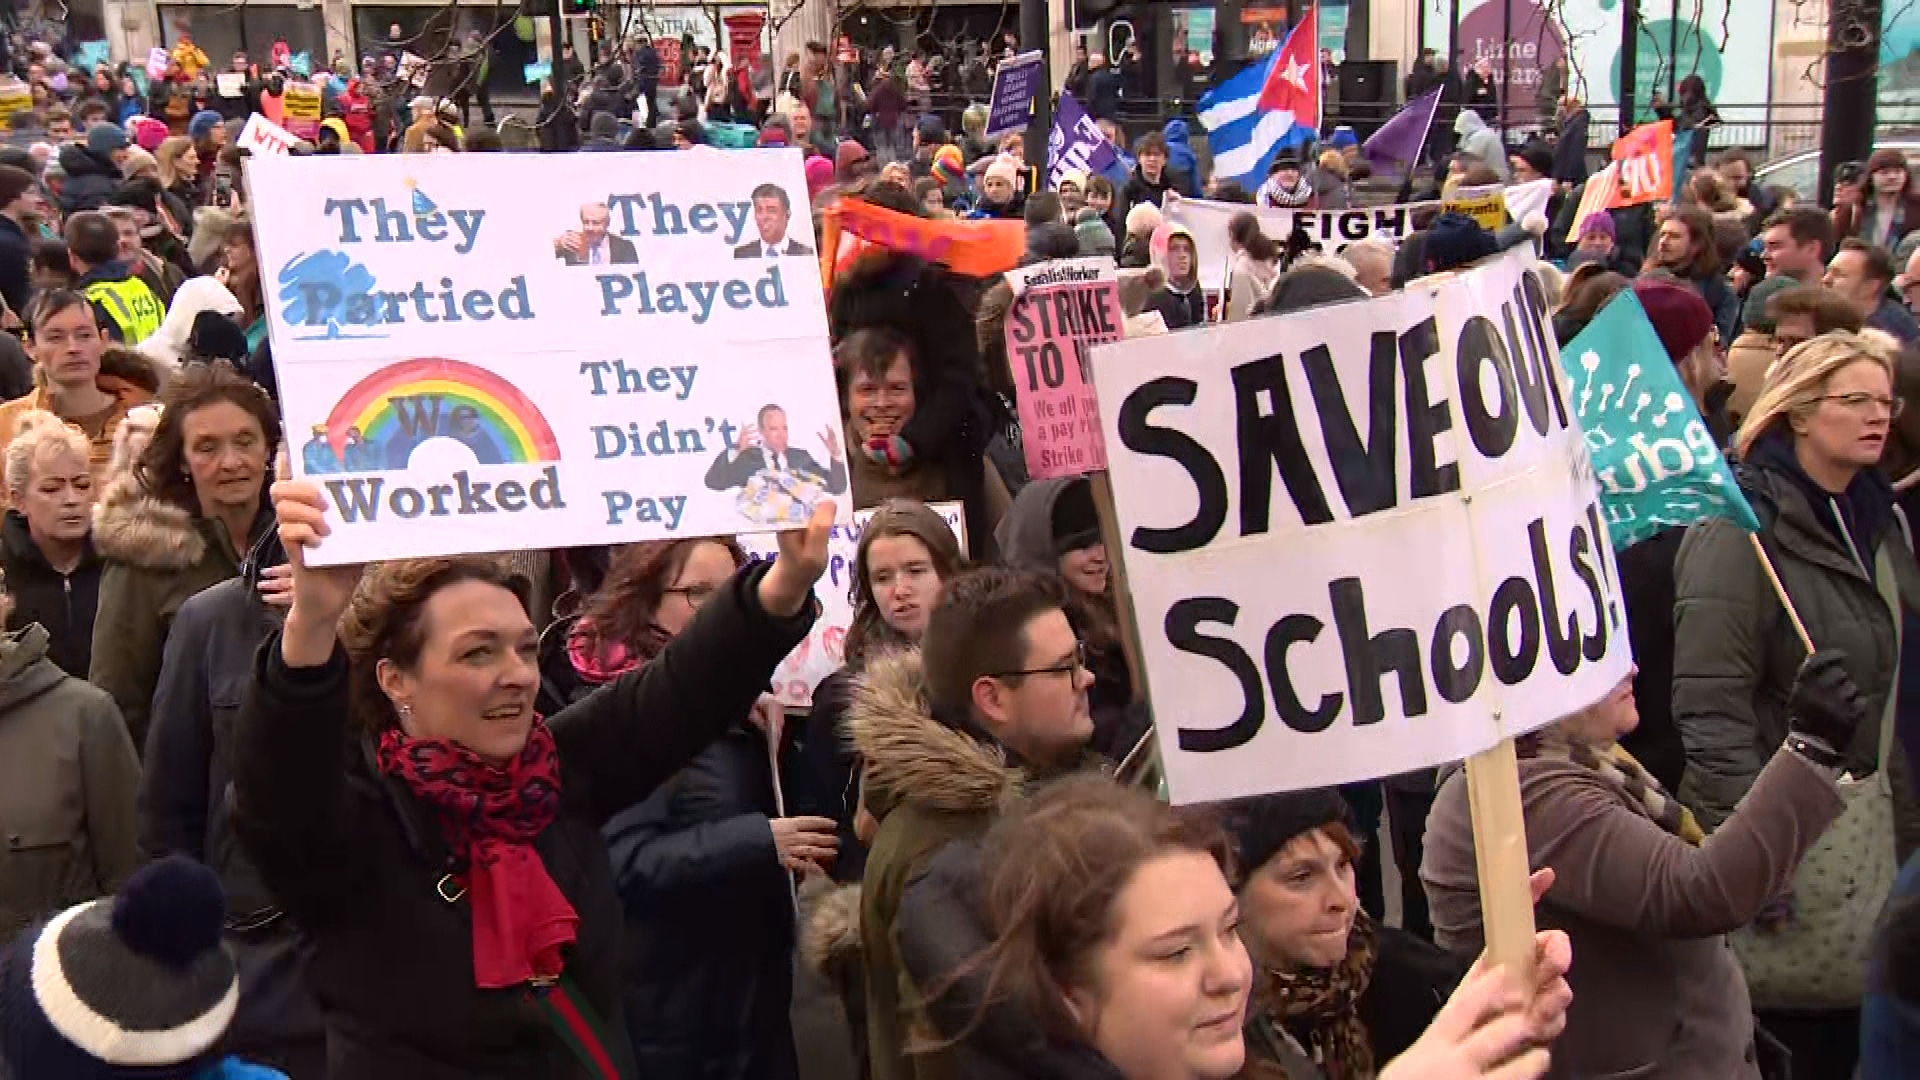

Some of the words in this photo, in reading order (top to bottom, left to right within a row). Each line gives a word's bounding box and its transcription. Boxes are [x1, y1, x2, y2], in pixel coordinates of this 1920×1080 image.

[325, 197, 486, 254] They
[608, 191, 752, 245] They
[1293, 208, 1405, 240] FIGH
[299, 275, 535, 325] Partied
[595, 265, 788, 323] Played
[1013, 287, 1115, 342] STRIKE
[579, 360, 698, 398] They
[1016, 341, 1065, 392] TO
[388, 395, 480, 440] We
[1034, 399, 1055, 419] We
[1059, 393, 1077, 417] all
[589, 416, 738, 459] Didn't
[1051, 421, 1074, 443] pay
[1117, 315, 1461, 554] SAVE
[1041, 445, 1083, 470] Strike
[325, 466, 566, 523] Worked
[602, 490, 687, 529] Pay
[1164, 504, 1620, 752] Schools!
